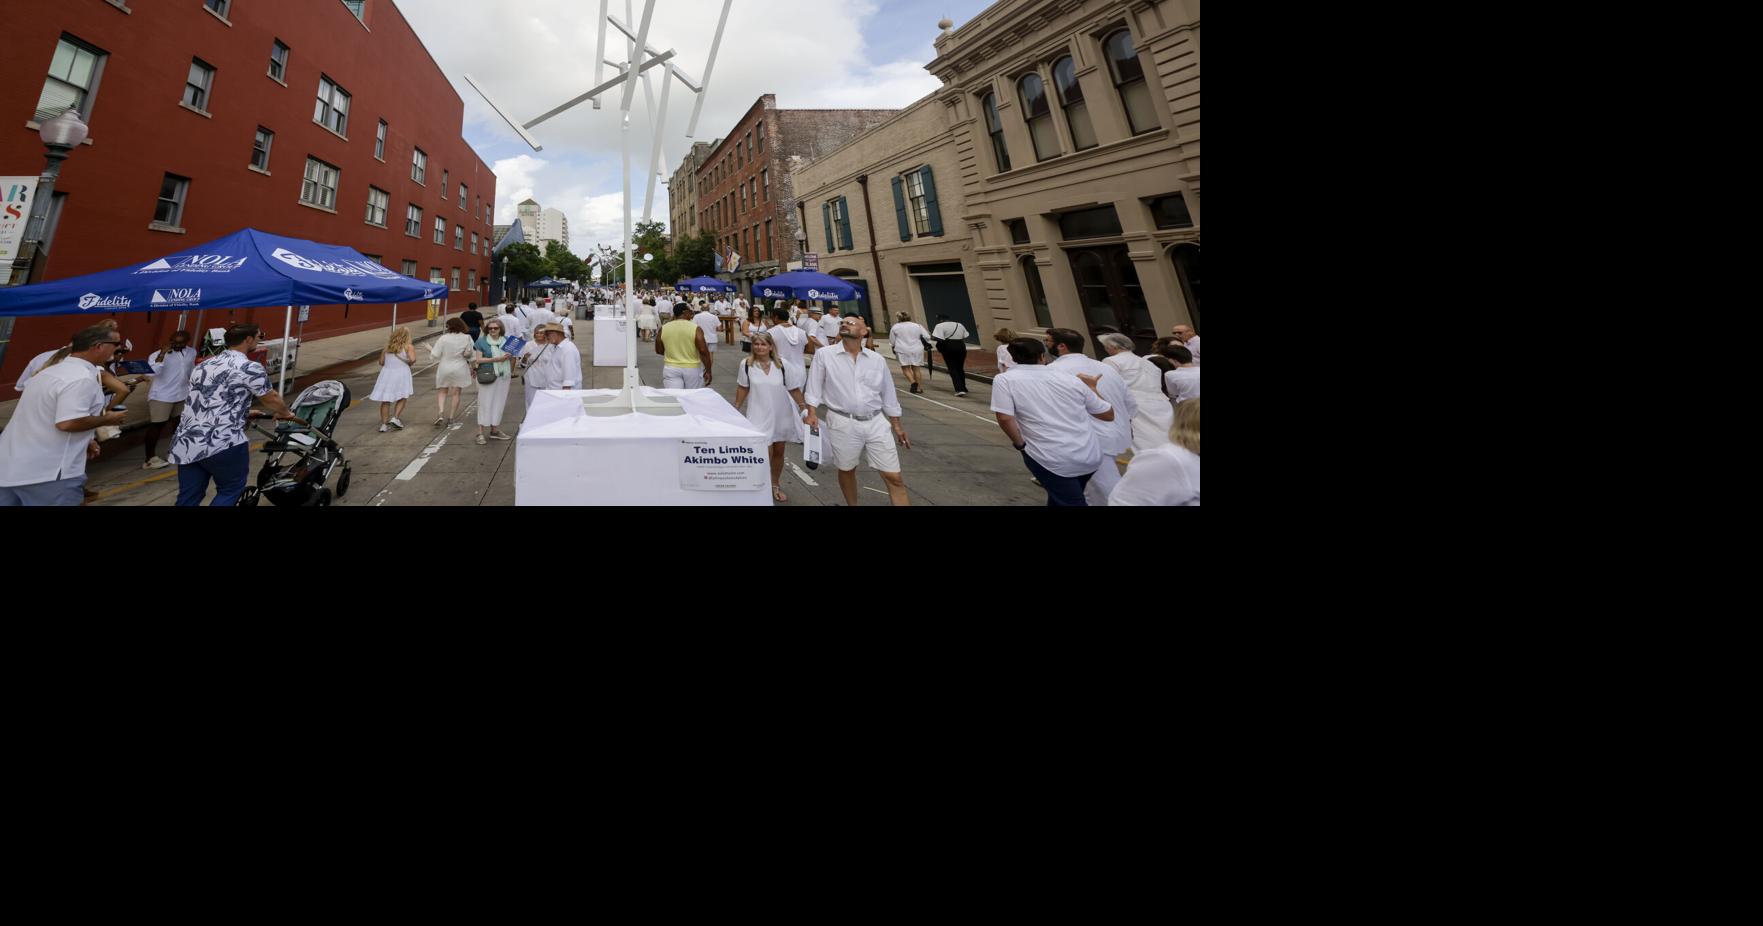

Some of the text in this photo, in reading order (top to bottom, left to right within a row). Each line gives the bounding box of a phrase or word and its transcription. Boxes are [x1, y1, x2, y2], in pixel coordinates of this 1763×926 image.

[184, 254, 248, 267] NOLA
[171, 288, 201, 298] NOLA
[79, 293, 132, 309] Fidelity
[693, 445, 754, 454] Ten Limbs
[684, 455, 765, 464] Akimbo White
